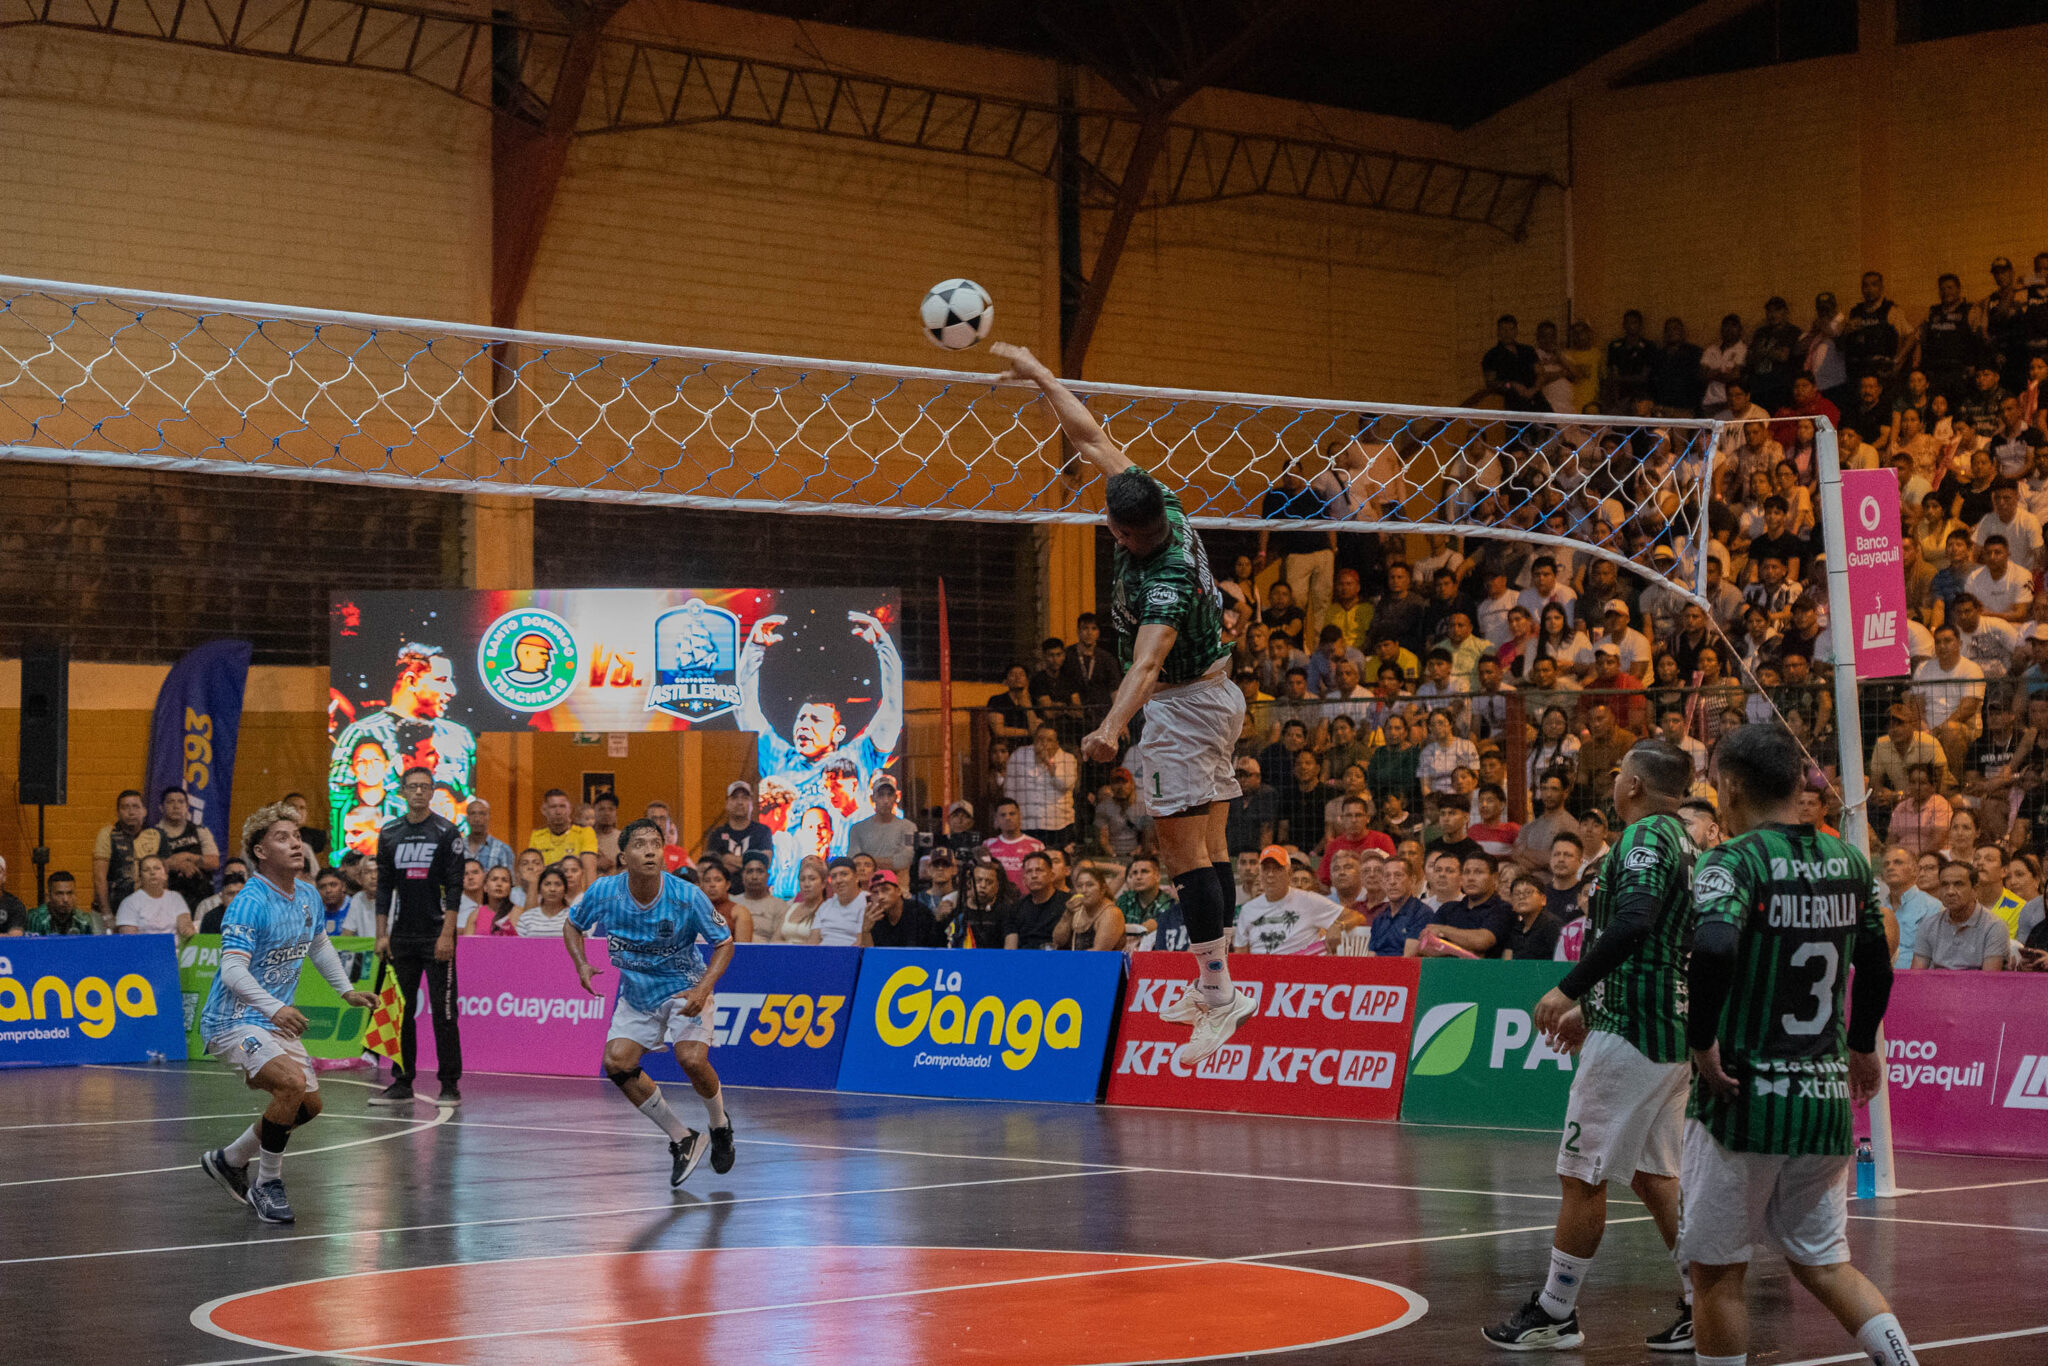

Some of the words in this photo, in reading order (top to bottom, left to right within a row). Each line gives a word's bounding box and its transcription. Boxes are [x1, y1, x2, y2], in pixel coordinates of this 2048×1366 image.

[1848, 548, 1900, 568] Guayaquil
[1856, 535, 1889, 551] Banco
[486, 619, 519, 658] SANTO
[521, 616, 575, 658] DOMINGO
[491, 675, 568, 704] TSACHILAS
[649, 683, 742, 706] ASTILLEROS
[1152, 771, 1163, 798] 1
[0, 956, 13, 975] a
[934, 968, 962, 992] La
[1265, 982, 1352, 1020] KFC
[1355, 990, 1402, 1018] APP
[1781, 941, 1840, 1036] 3
[0, 973, 158, 1039] anga
[496, 992, 606, 1025] Guayaquil
[664, 992, 846, 1048] ET593
[875, 965, 1083, 1071] Ganga
[0, 1027, 70, 1044] mprobado!
[1489, 1008, 1573, 1071] PA
[1884, 1039, 1938, 1060] nco
[913, 1051, 992, 1069] ¡Comprobado!
[1253, 1047, 1341, 1085] KFC
[1344, 1055, 1389, 1083] APP
[1886, 1061, 1985, 1091] ayaquil
[1565, 1121, 1582, 1152] 2
